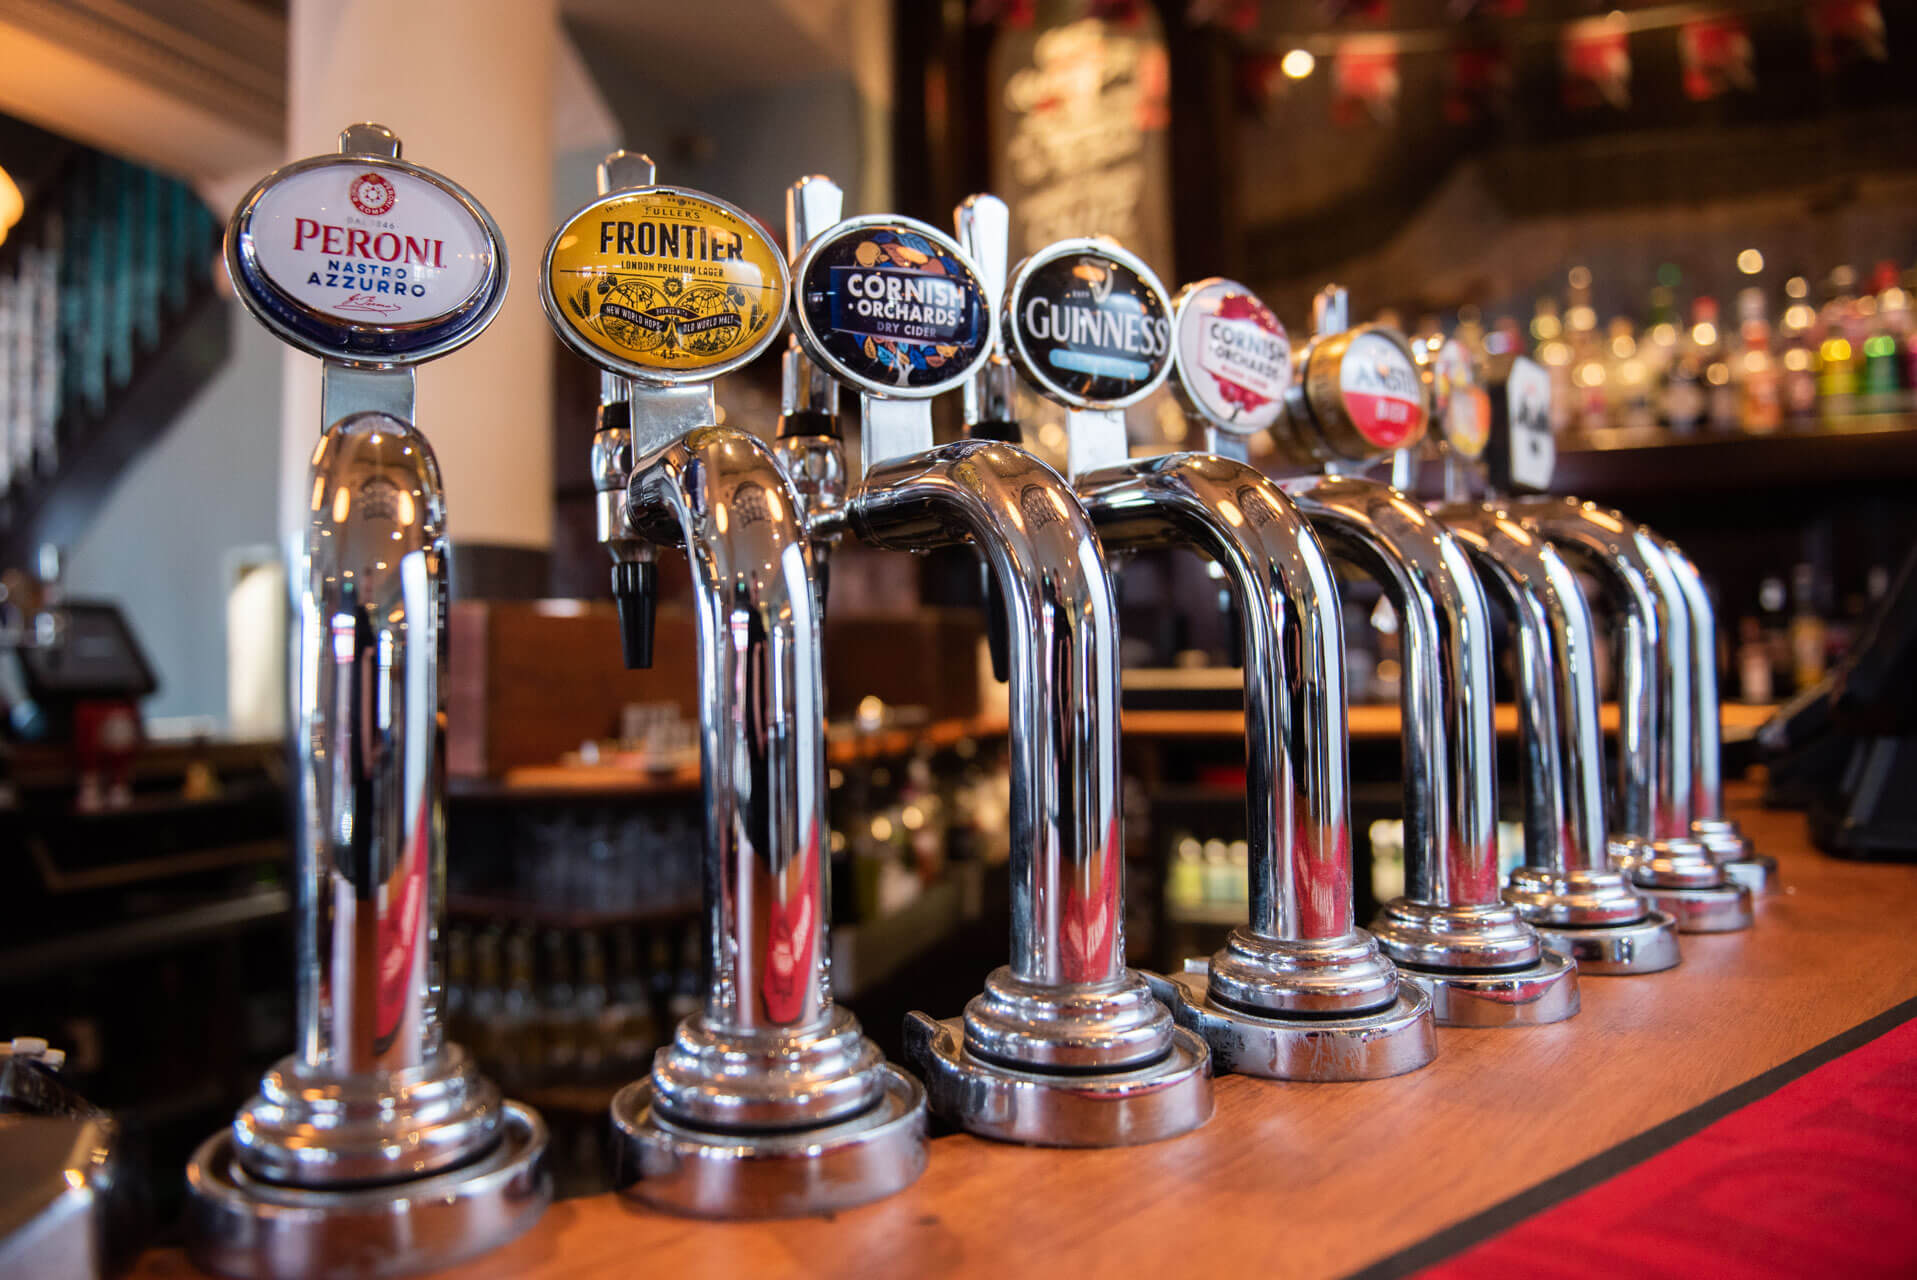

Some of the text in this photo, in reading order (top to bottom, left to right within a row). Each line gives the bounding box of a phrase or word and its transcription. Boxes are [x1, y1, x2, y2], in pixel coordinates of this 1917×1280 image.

[293, 218, 444, 268] PERONI
[600, 221, 743, 263] FRONTIER
[328, 259, 407, 279] NASTRO
[621, 260, 724, 277] LONDON PREMIUM LAGER
[307, 272, 426, 297] AZZURRO
[848, 273, 966, 310] CORNISH
[606, 305, 661, 332] NEW WORLD HOPS
[682, 314, 735, 333] OLD WORLD MALT
[876, 321, 937, 338] DRY CIDER
[1026, 296, 1169, 357] GUINNESS
[1210, 323, 1286, 366] CORNISH
